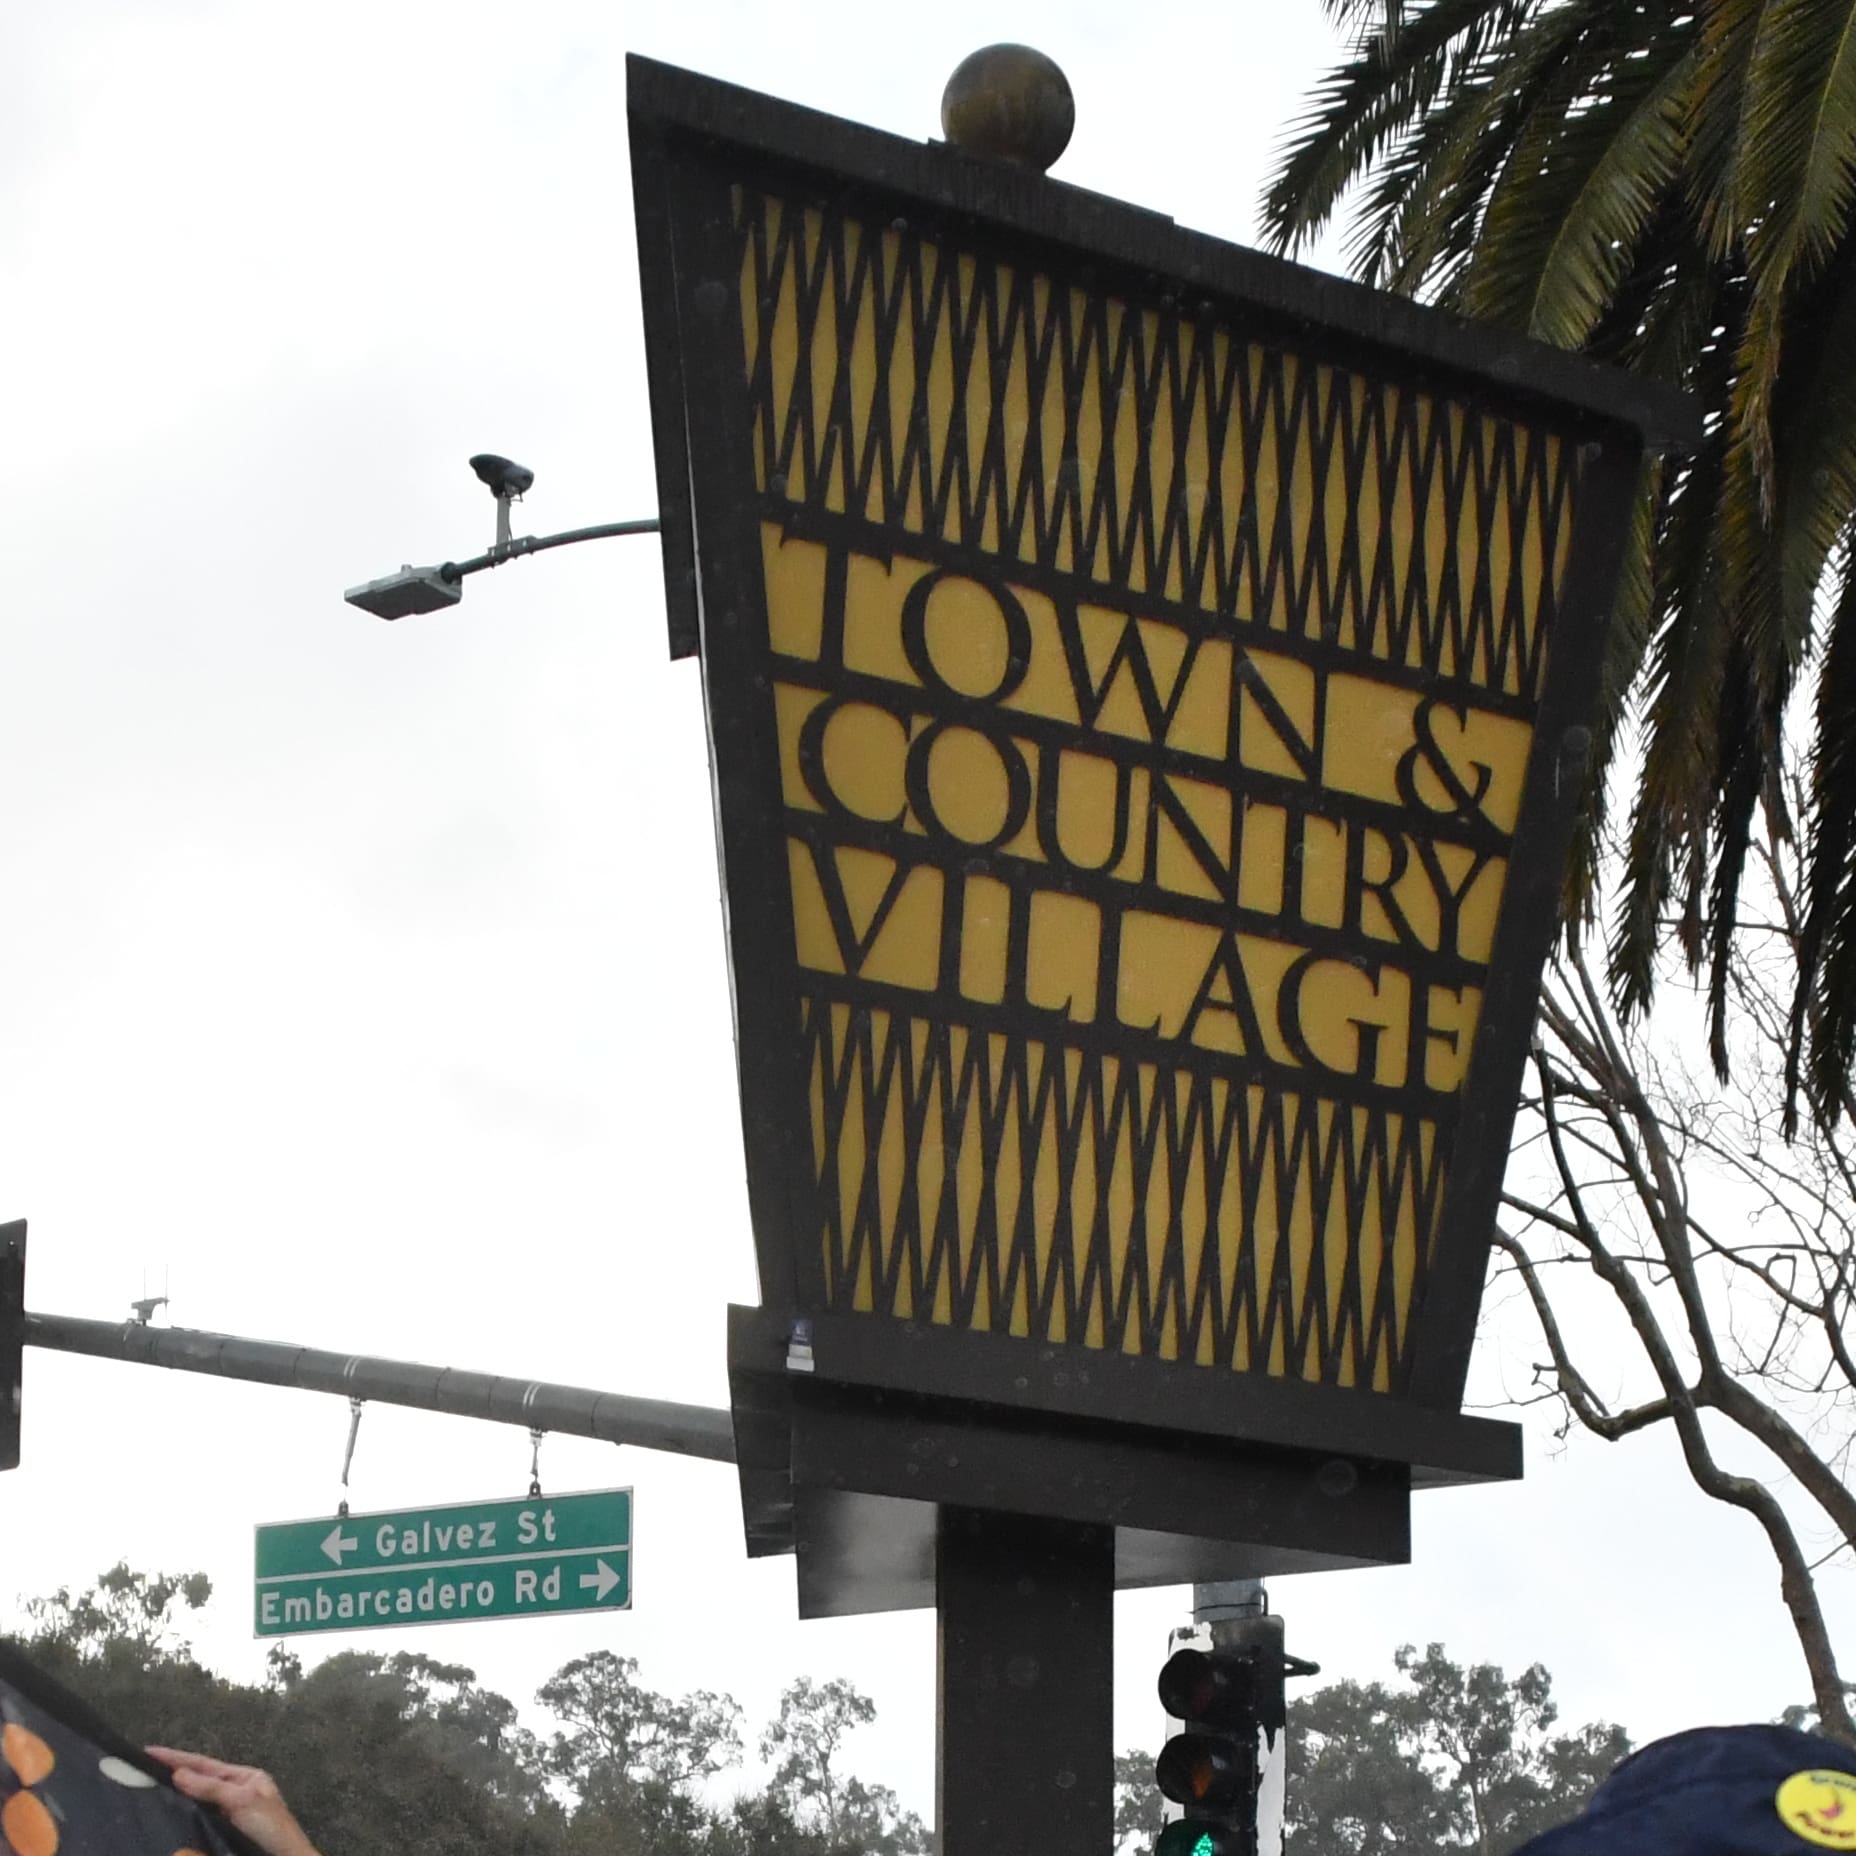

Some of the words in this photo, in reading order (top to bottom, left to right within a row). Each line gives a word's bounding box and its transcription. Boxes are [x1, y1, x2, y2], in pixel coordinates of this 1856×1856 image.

[776, 538, 1324, 787] TOWN
[1396, 697, 1494, 824] &
[797, 690, 1509, 957] COUNTRY
[802, 842, 1481, 1091] VILLAGE
[260, 1578, 495, 1625] Embarcadero
[514, 1565, 561, 1603] Rd
[376, 1520, 496, 1558] Galvez
[517, 1510, 556, 1544] St
